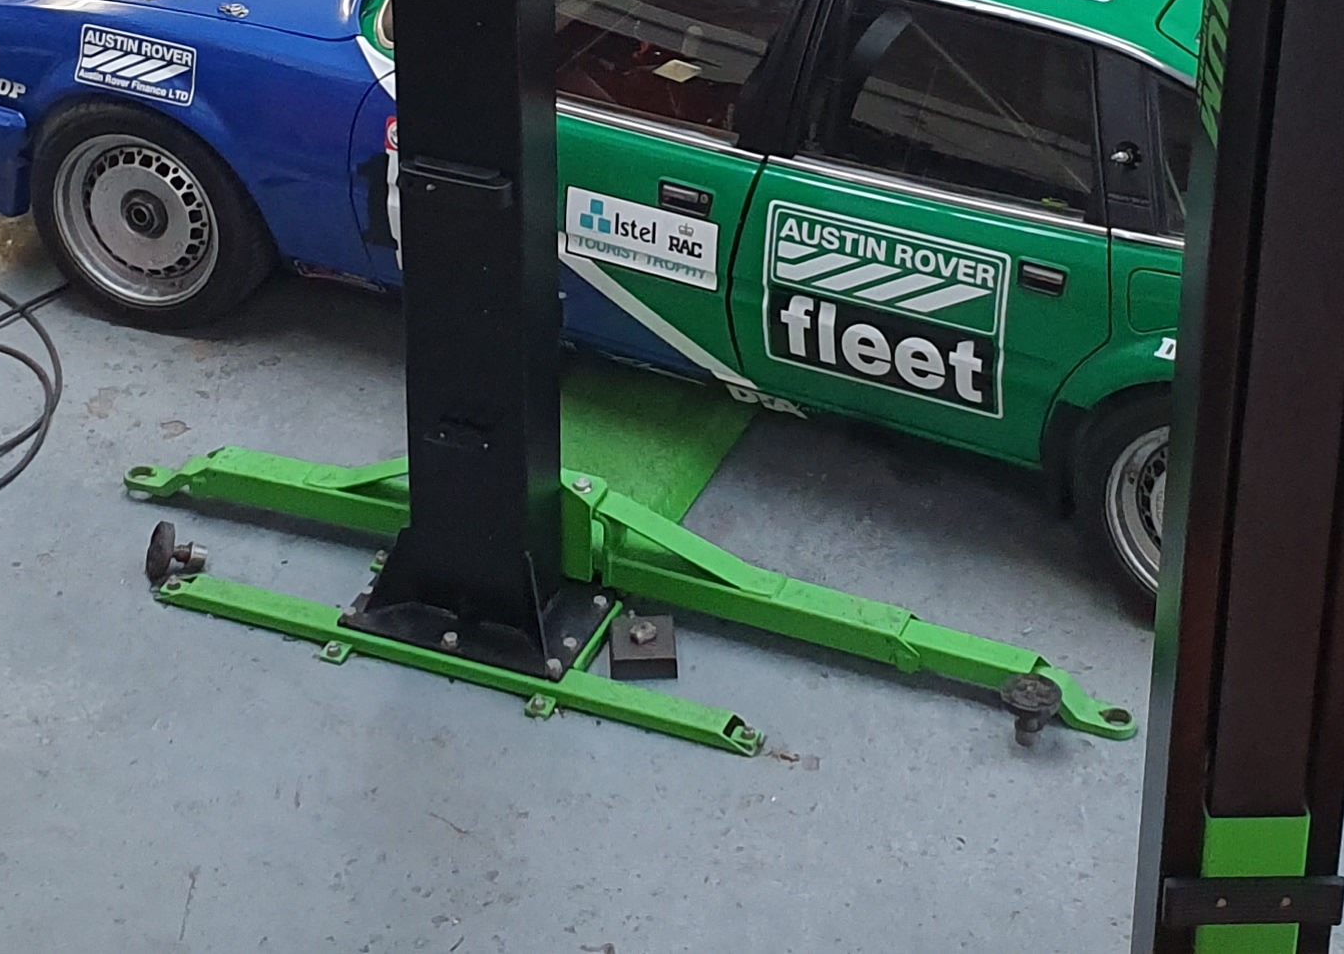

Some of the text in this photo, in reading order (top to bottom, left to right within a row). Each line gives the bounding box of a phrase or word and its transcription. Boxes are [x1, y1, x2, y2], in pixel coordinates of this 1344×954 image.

[84, 30, 192, 66] AUSTIN ROVER
[78, 68, 189, 102] Austin Rover Finance LTD
[575, 235, 708, 279] TOURIST TROPHY
[615, 213, 703, 259] Istel RAC
[779, 218, 996, 289] AUSTIN ROVER
[779, 294, 984, 404] fleet
